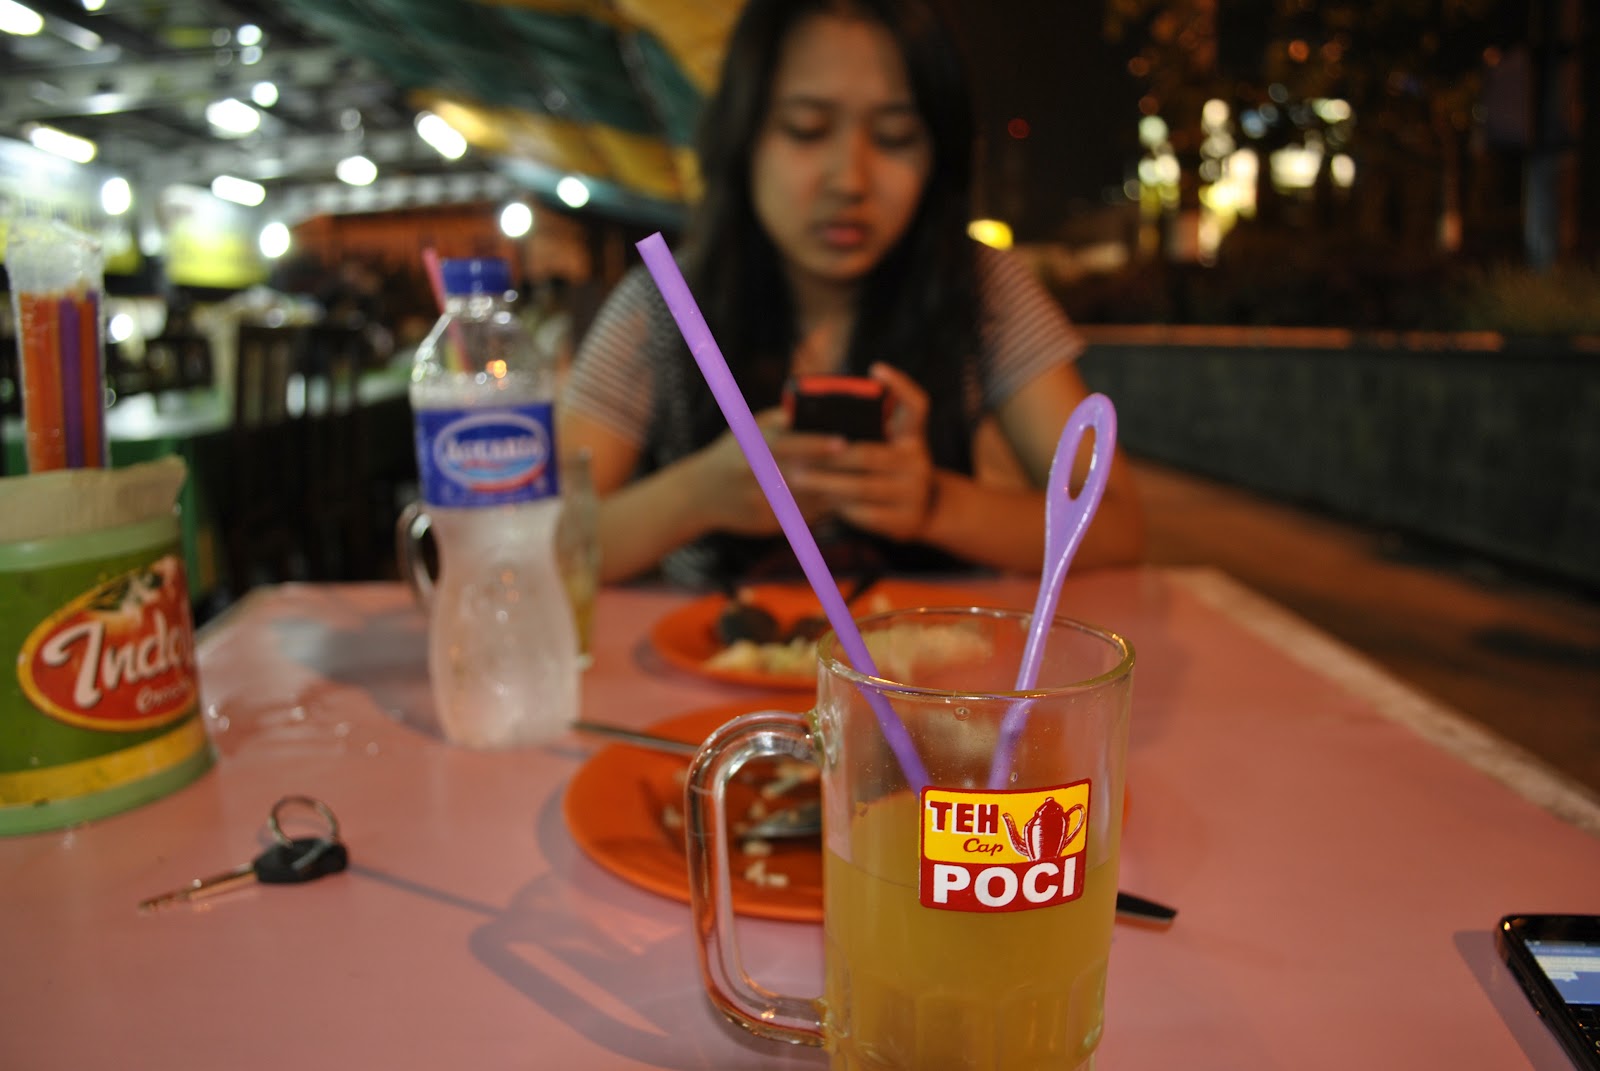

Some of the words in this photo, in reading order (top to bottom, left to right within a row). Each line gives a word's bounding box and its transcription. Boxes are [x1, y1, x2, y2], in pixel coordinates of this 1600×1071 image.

[926, 800, 999, 836] TEH
[963, 838, 1004, 856] Cap
[932, 856, 1077, 907] POCI
